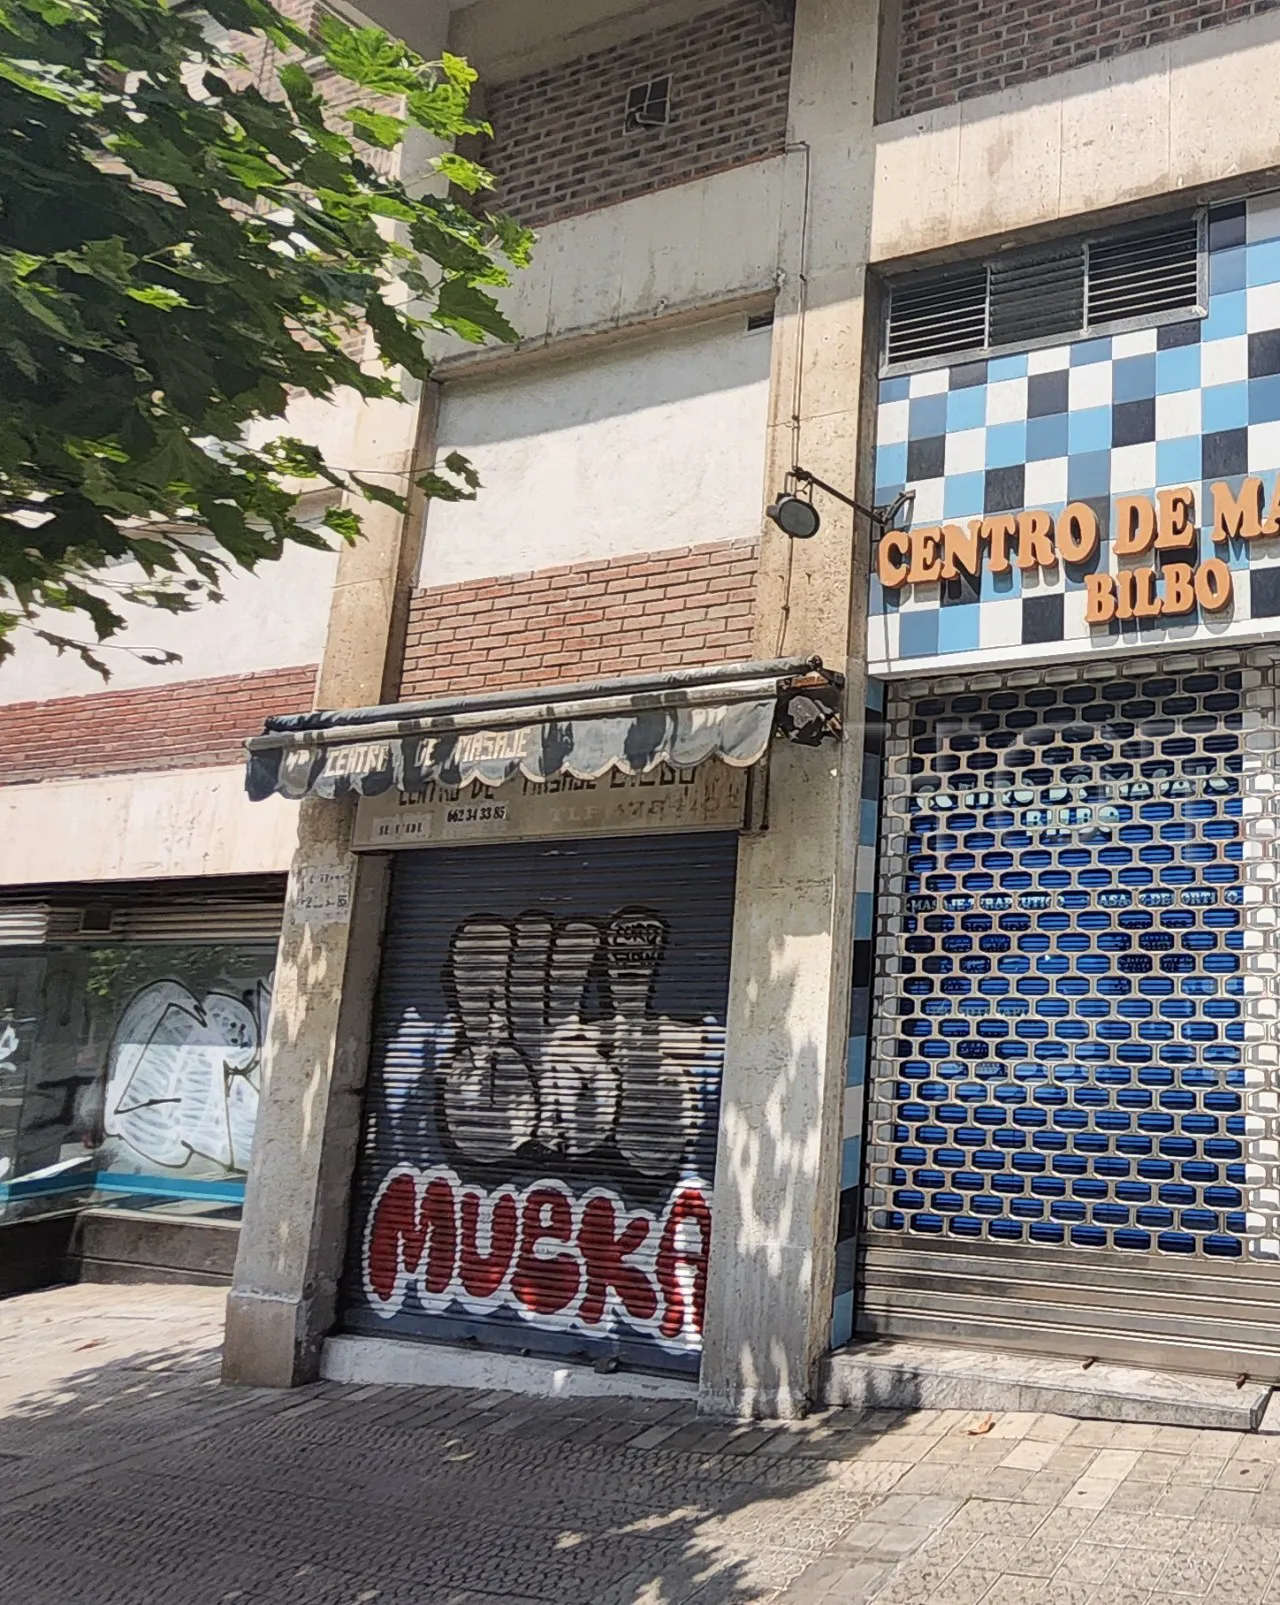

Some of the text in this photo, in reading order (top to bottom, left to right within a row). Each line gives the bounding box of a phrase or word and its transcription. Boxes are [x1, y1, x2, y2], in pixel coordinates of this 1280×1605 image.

[876, 505, 1100, 589] CENTRO
[1111, 485, 1196, 557] DE
[1083, 557, 1233, 625] BILBO
[450, 728, 531, 769] MASAJE
